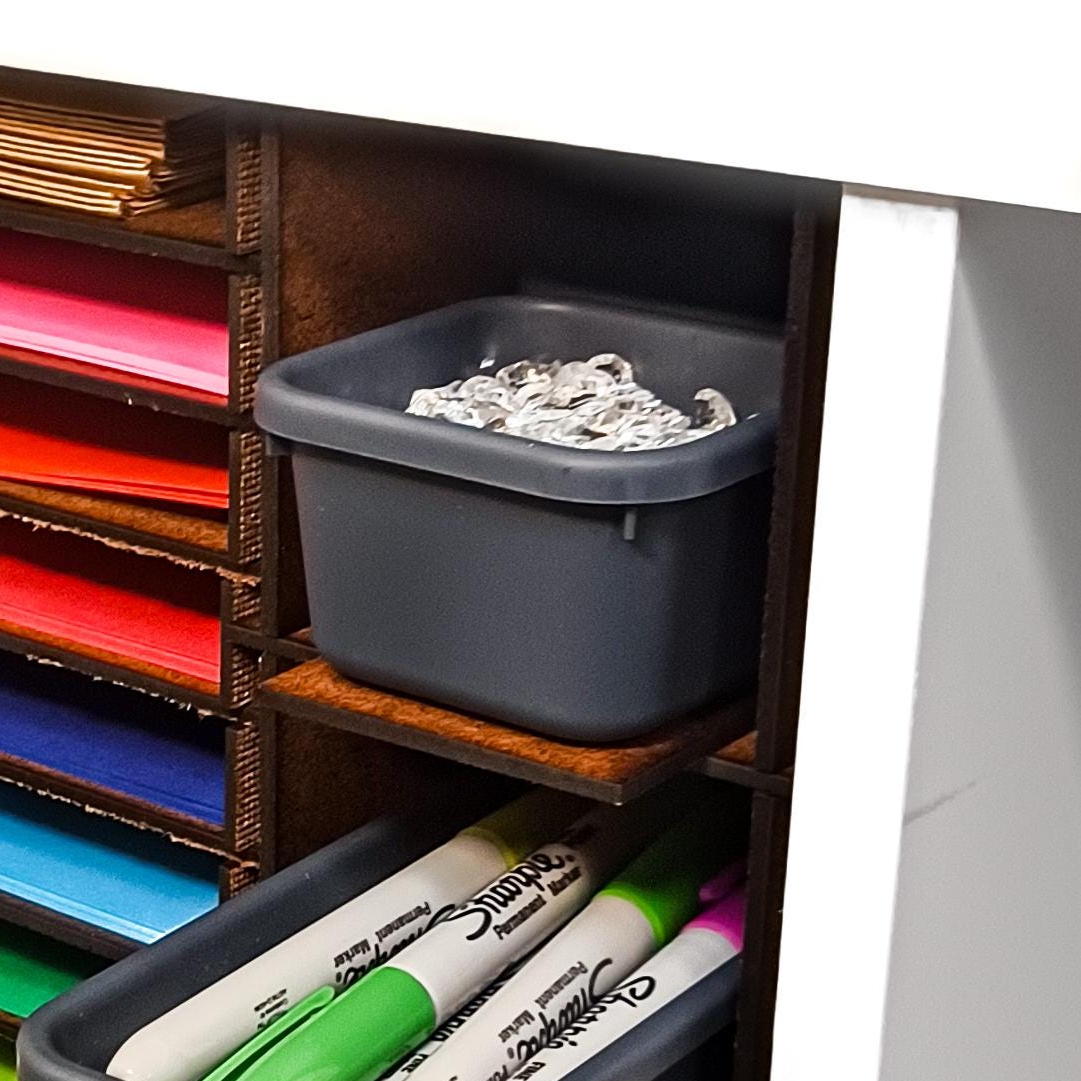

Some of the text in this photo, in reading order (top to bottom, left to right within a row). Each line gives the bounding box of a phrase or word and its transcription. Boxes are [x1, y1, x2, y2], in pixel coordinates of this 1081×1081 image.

[333, 901, 432, 969] Permanent Marker
[493, 893, 547, 940] Permanent
[534, 960, 588, 1010] Permanent
[497, 1009, 535, 1043] Marker
